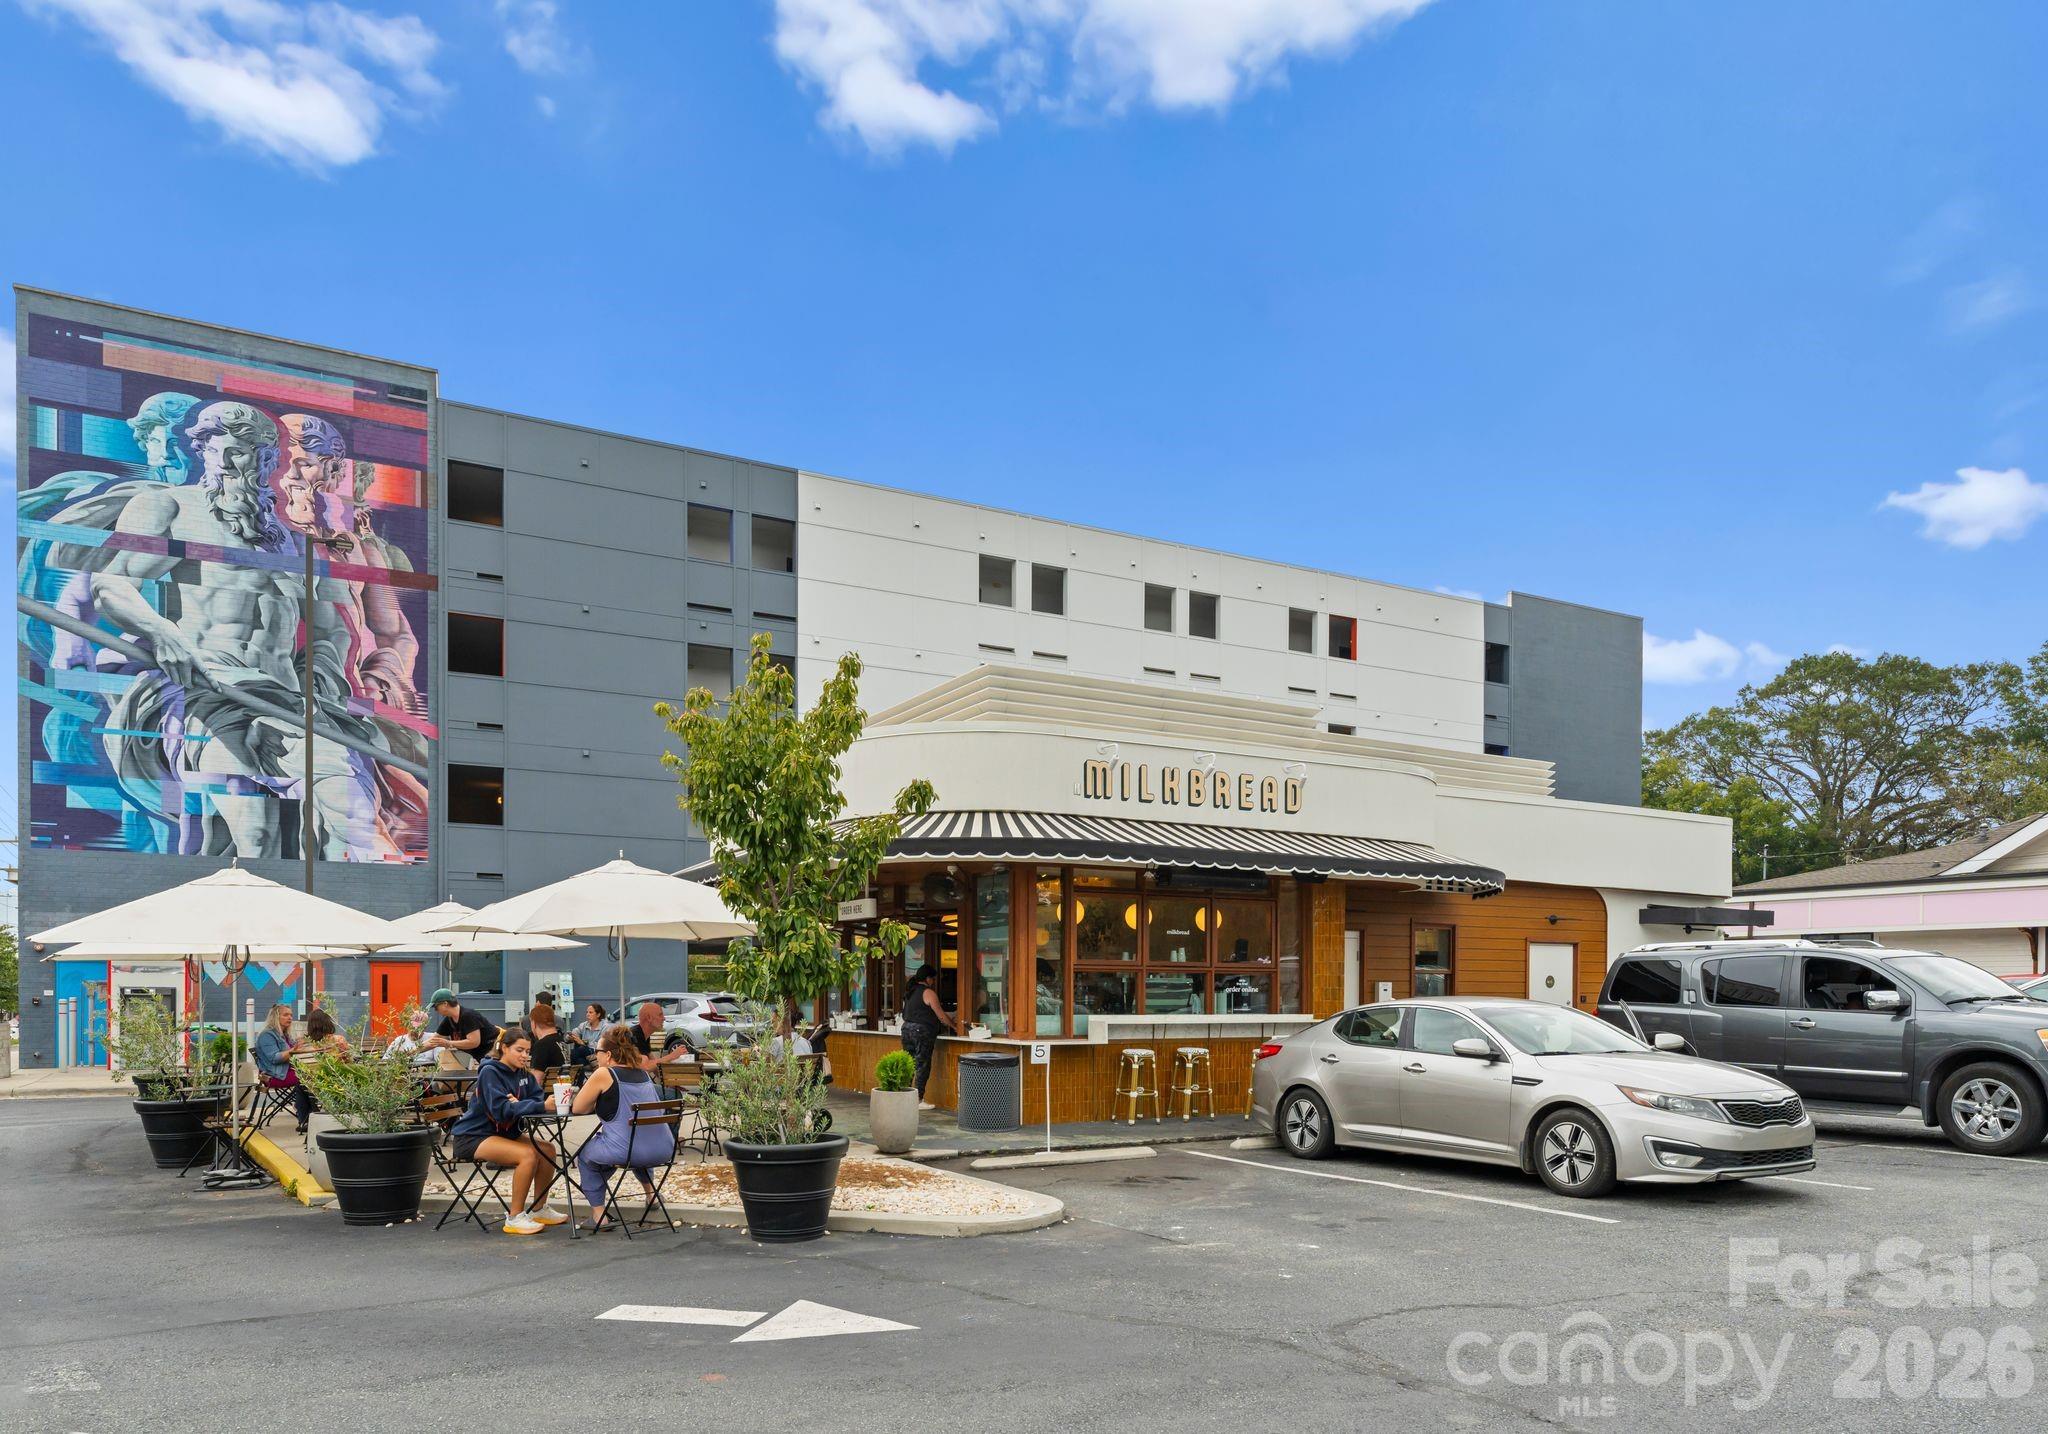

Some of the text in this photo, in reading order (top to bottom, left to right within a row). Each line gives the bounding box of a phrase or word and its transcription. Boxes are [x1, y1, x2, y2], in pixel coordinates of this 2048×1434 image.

[1083, 759, 1302, 815] MILKBREAD
[853, 904, 863, 914] HERE
[1035, 1045, 1045, 1057] 5
